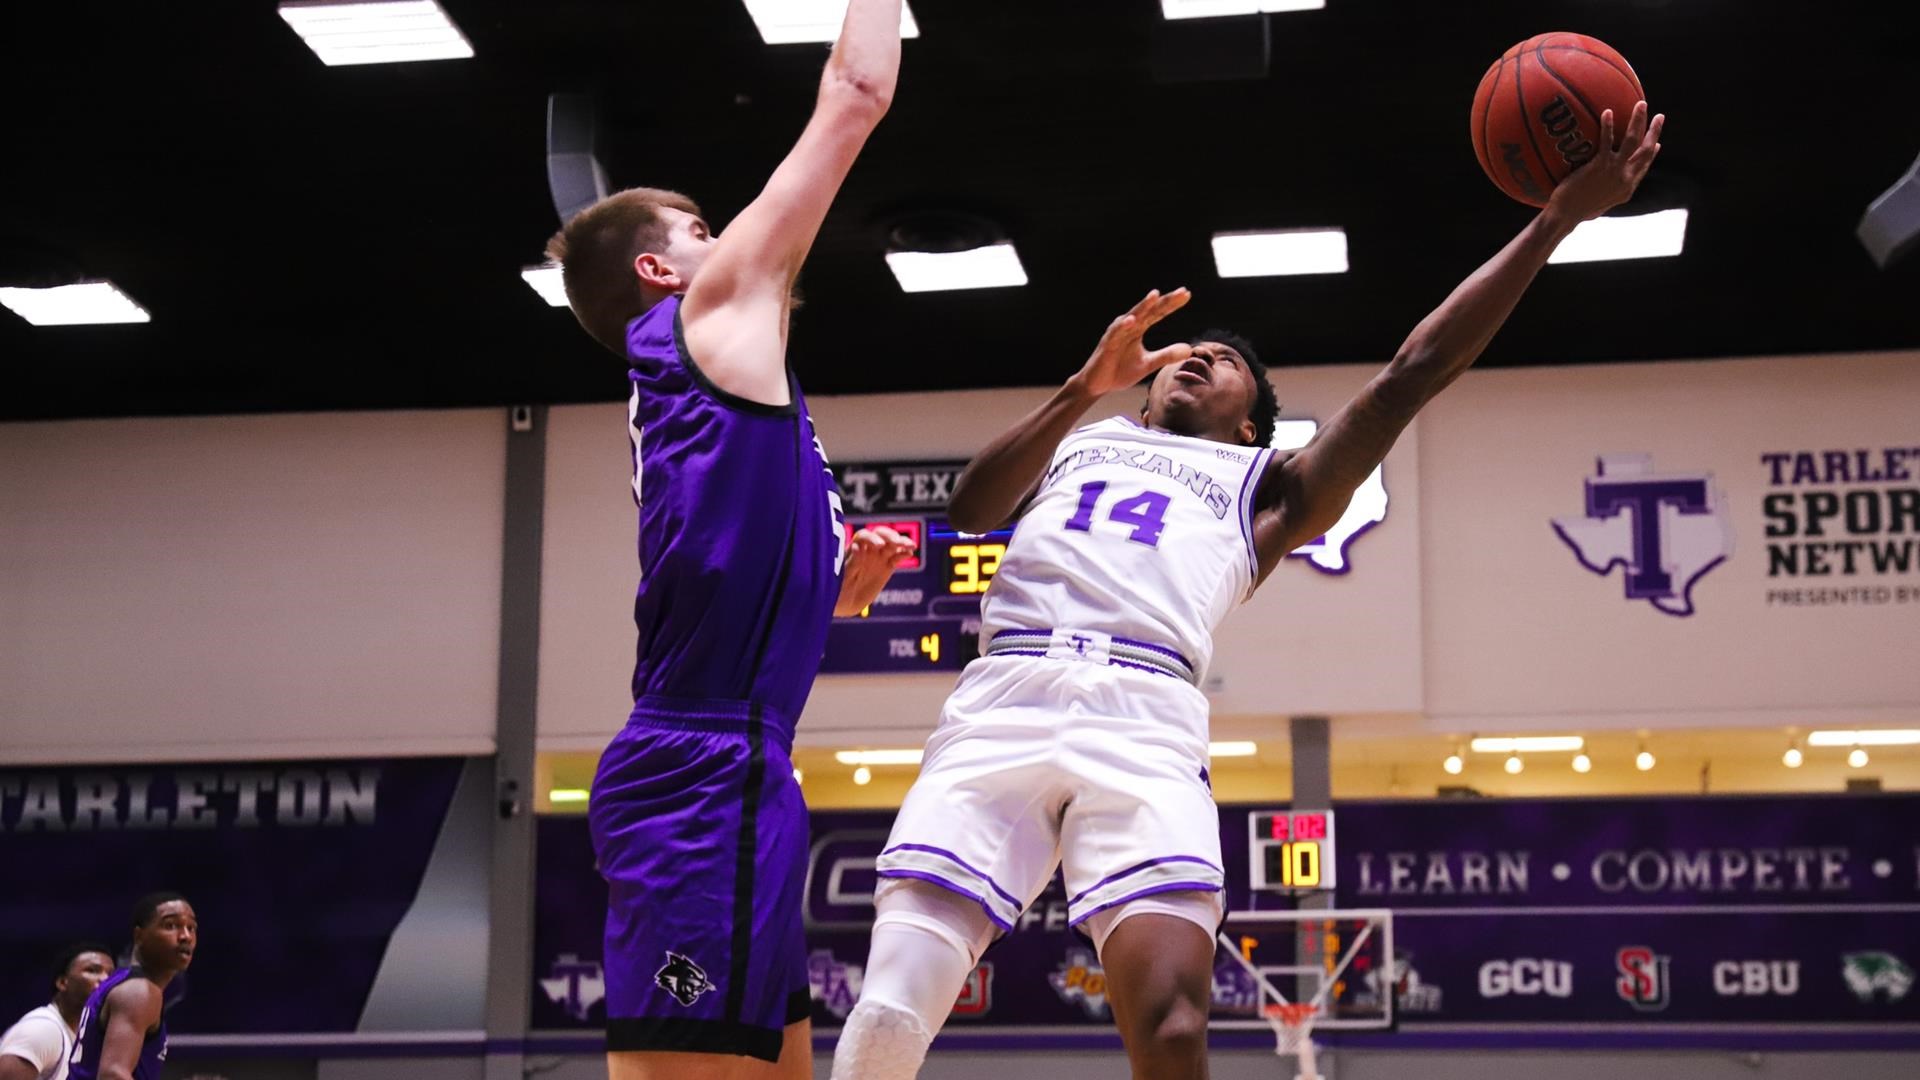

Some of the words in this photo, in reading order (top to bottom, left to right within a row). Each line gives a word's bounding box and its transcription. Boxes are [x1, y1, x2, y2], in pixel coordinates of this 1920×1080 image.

[1540, 95, 1594, 170] Wil
[1215, 448, 1251, 466] WAC
[1063, 479, 1173, 552] 14
[949, 544, 1006, 594] 33
[1766, 540, 1920, 577] NETW
[1766, 586, 1891, 607] PRESENTED
[889, 638, 917, 658] TOL
[920, 632, 939, 662] 4
[1281, 841, 1320, 887] 10
[1357, 851, 1531, 895] LEARN
[1590, 848, 1851, 892] COMPETE
[1478, 957, 1574, 998] GCU
[1712, 960, 1800, 996] CBU
